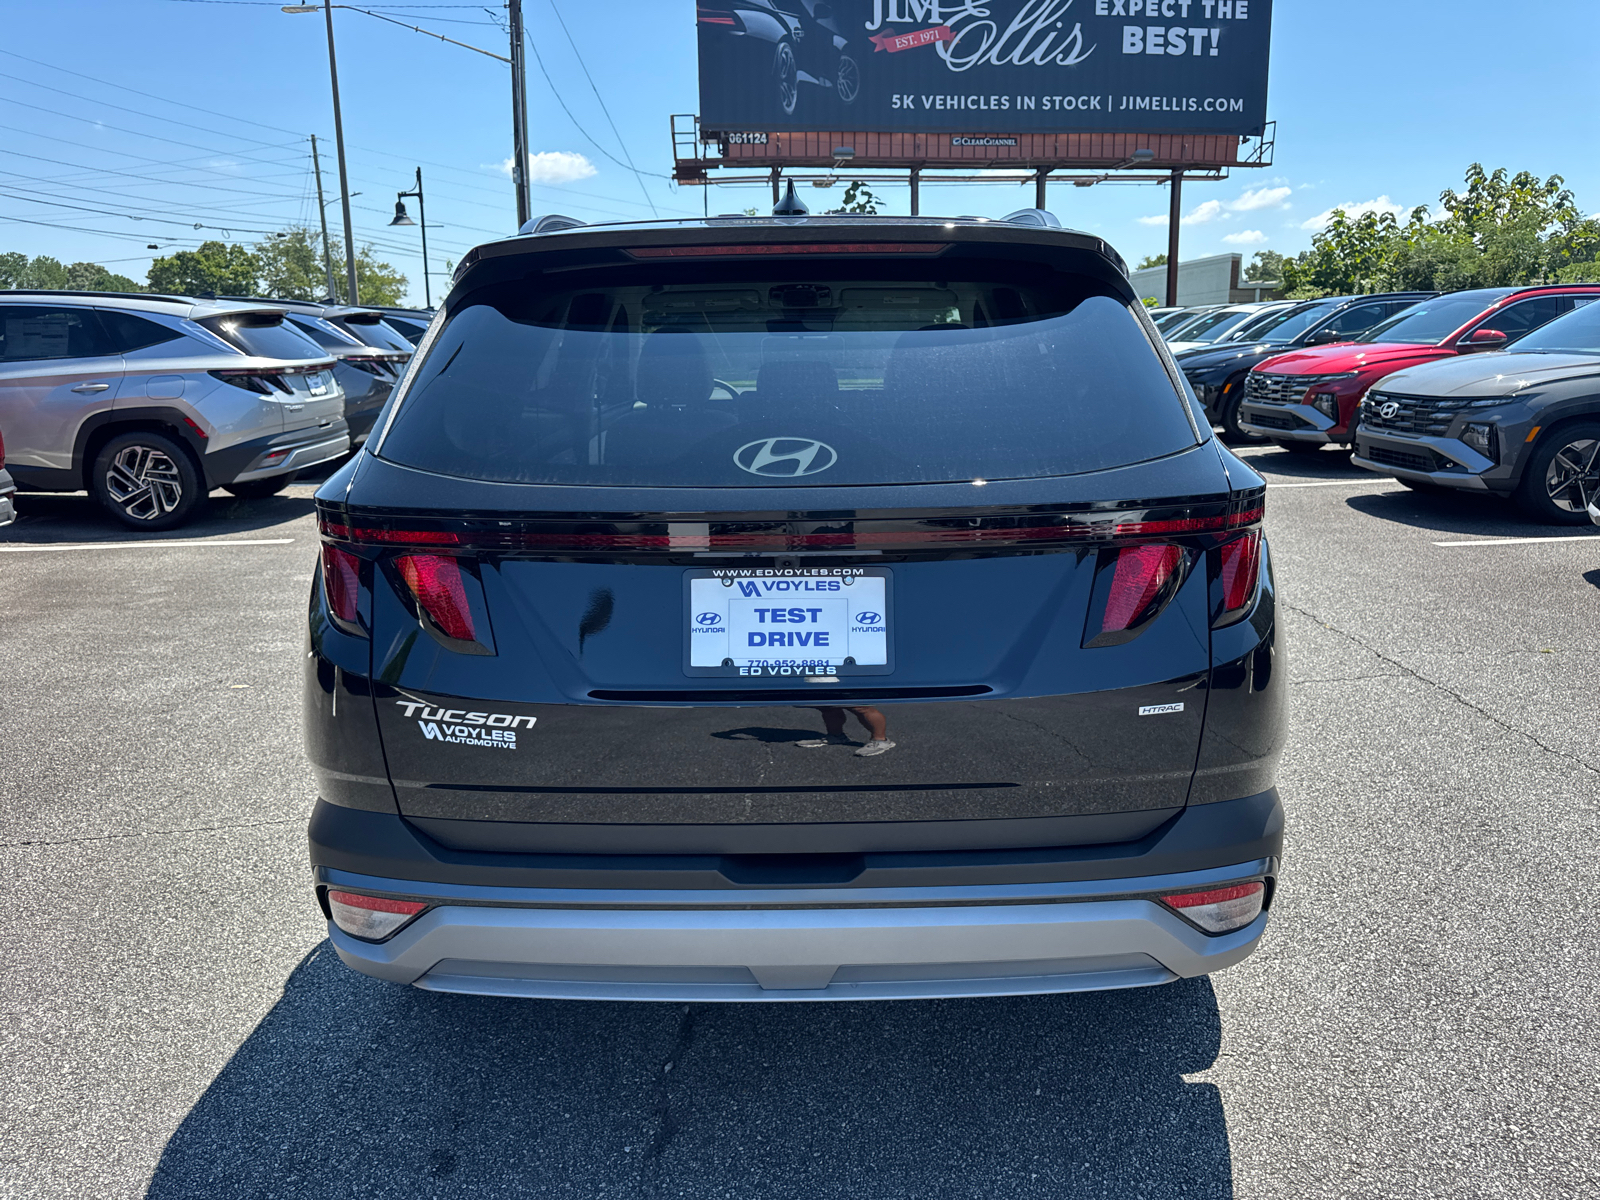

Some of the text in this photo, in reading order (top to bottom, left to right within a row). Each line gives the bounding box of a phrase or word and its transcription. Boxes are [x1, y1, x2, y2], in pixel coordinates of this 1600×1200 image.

[1095, 0, 1249, 20] EXPECT THE
[865, 0, 1097, 72] JIM Ellis
[895, 30, 940, 49] EST. 1971
[1122, 25, 1221, 57] BEST!
[891, 94, 1244, 113] 5K VEHICLES IN STOCK JIMELLIS.COM
[728, 132, 768, 144] 061124
[712, 568, 864, 577] WWW.EDVOYLES.COM
[762, 580, 841, 592] VOYLES
[753, 608, 823, 624] TEST
[747, 631, 830, 647] DRIVE
[739, 666, 837, 676] ED VOYLES
[747, 659, 830, 667] 770-952-8881
[1142, 704, 1181, 714] HTRAC
[441, 723, 517, 742] VOYLES
[444, 735, 517, 750] AUTOMOTIVE
